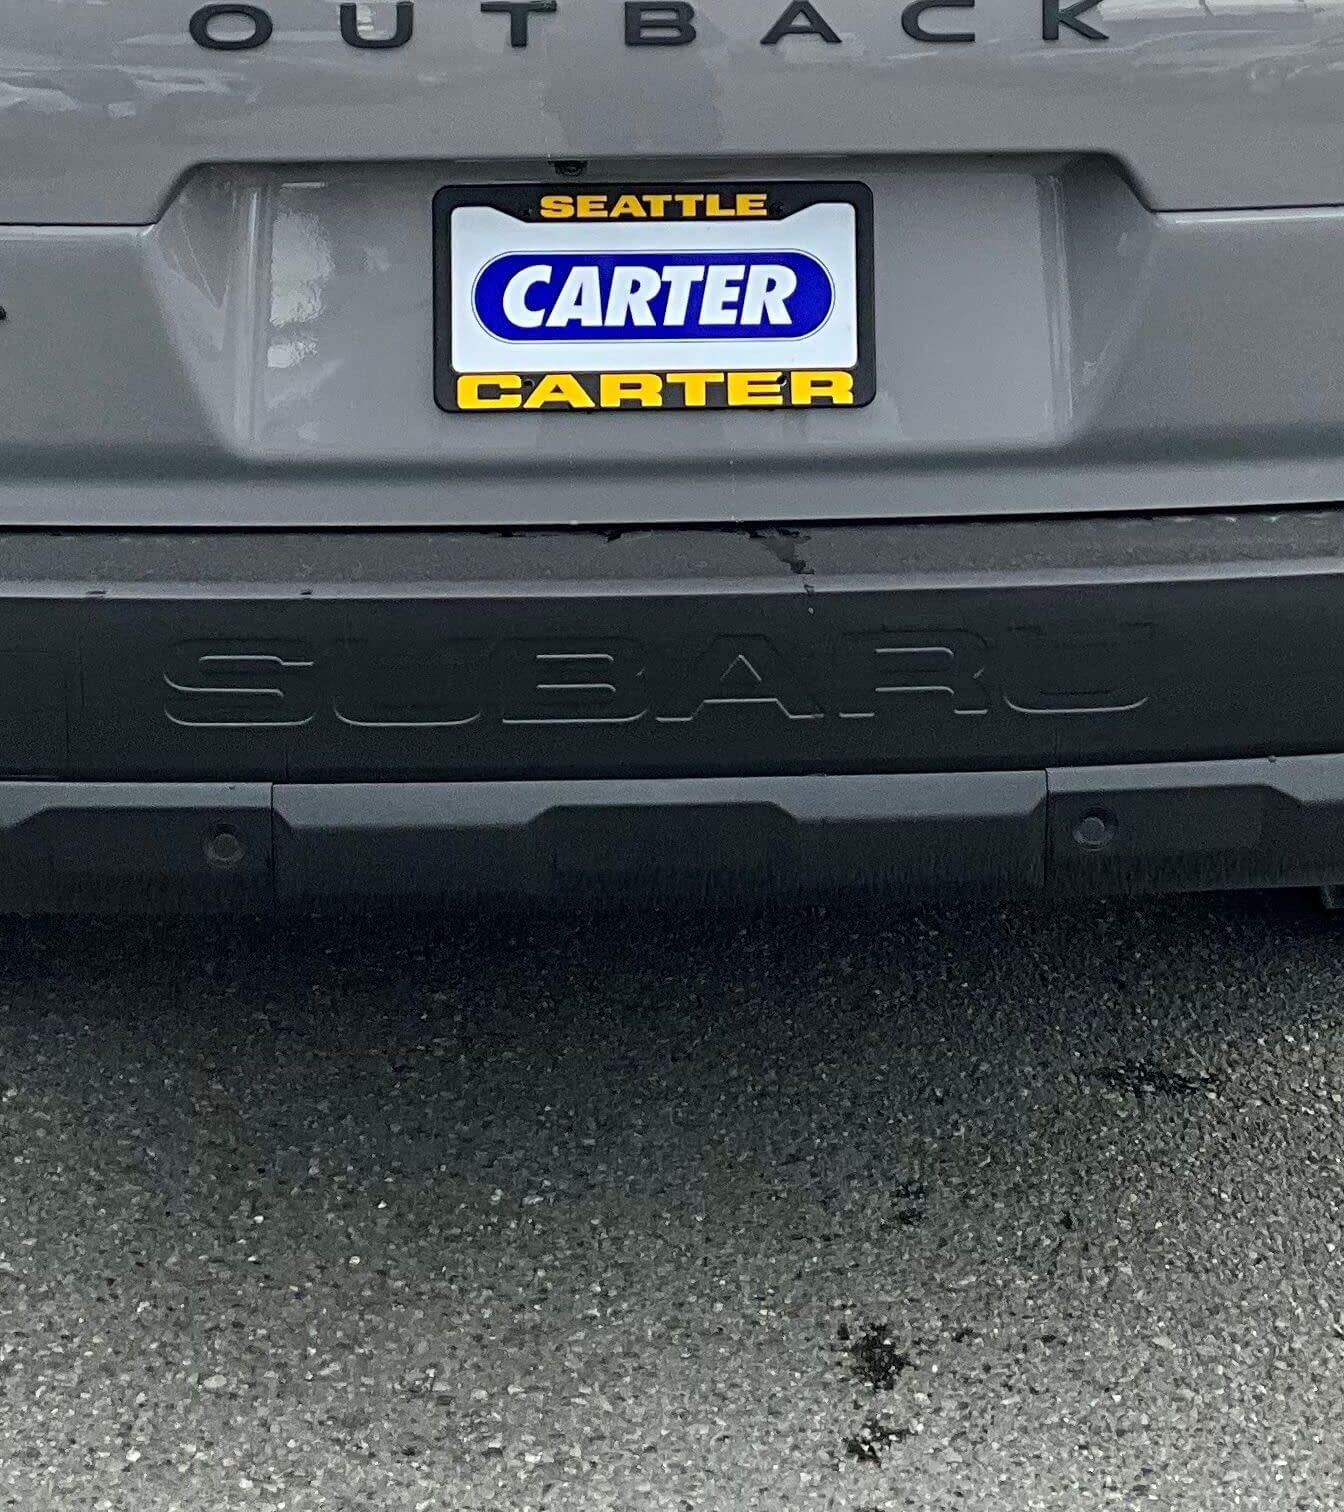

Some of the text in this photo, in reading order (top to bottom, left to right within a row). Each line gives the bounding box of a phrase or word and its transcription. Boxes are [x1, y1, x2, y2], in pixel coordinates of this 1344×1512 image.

[540, 193, 767, 219] SEATTLE
[502, 264, 797, 328] CARTER
[457, 370, 854, 410] CARTER
[162, 623, 1152, 727] SUBARU
